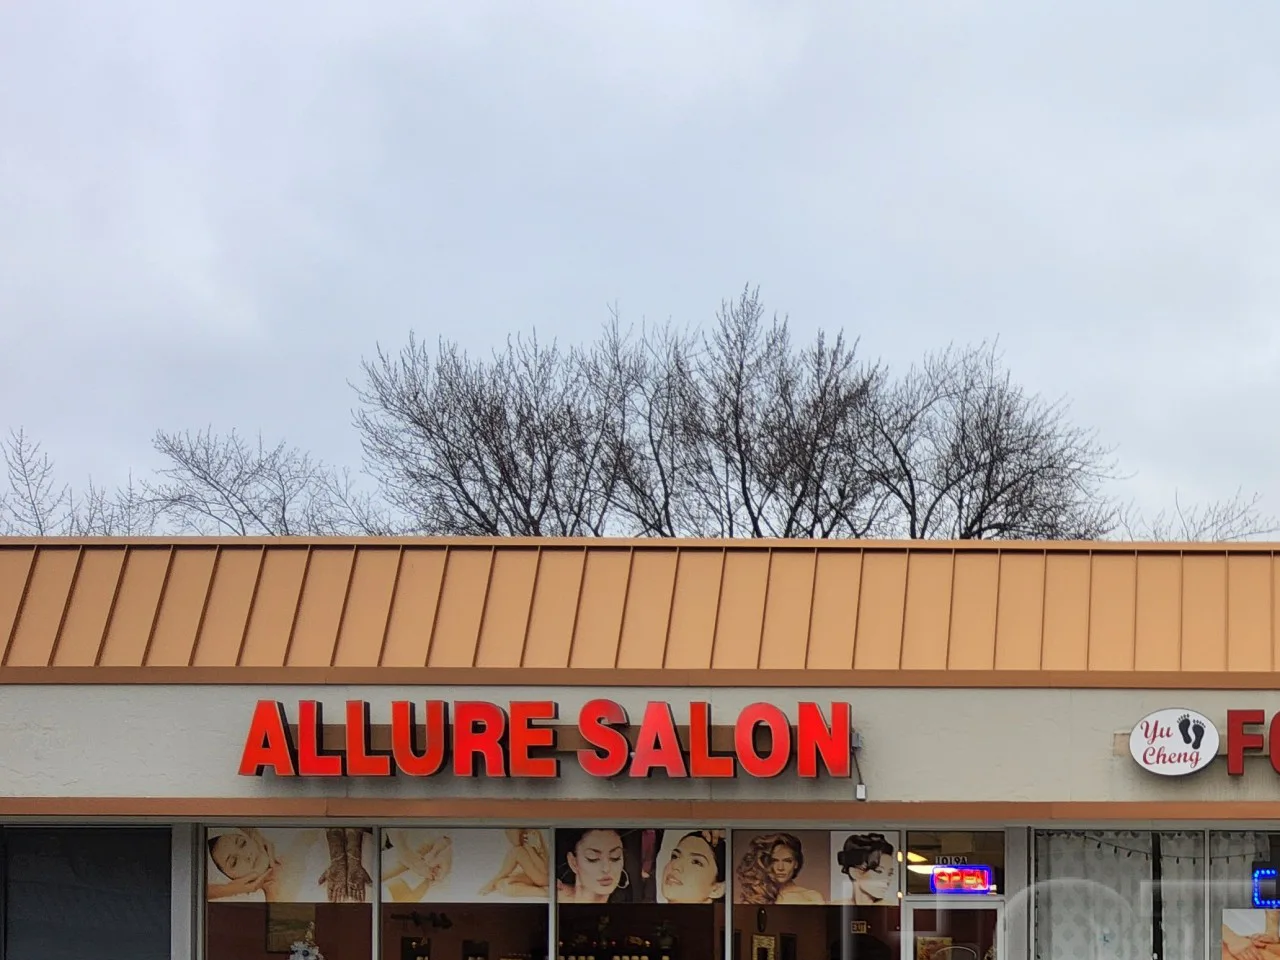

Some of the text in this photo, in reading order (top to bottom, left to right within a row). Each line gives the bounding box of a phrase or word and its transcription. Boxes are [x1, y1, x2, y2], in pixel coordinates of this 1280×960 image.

[238, 698, 852, 778] ALLURE SALON
[1140, 719, 1174, 746] Yu
[1142, 745, 1202, 769] Cheng
